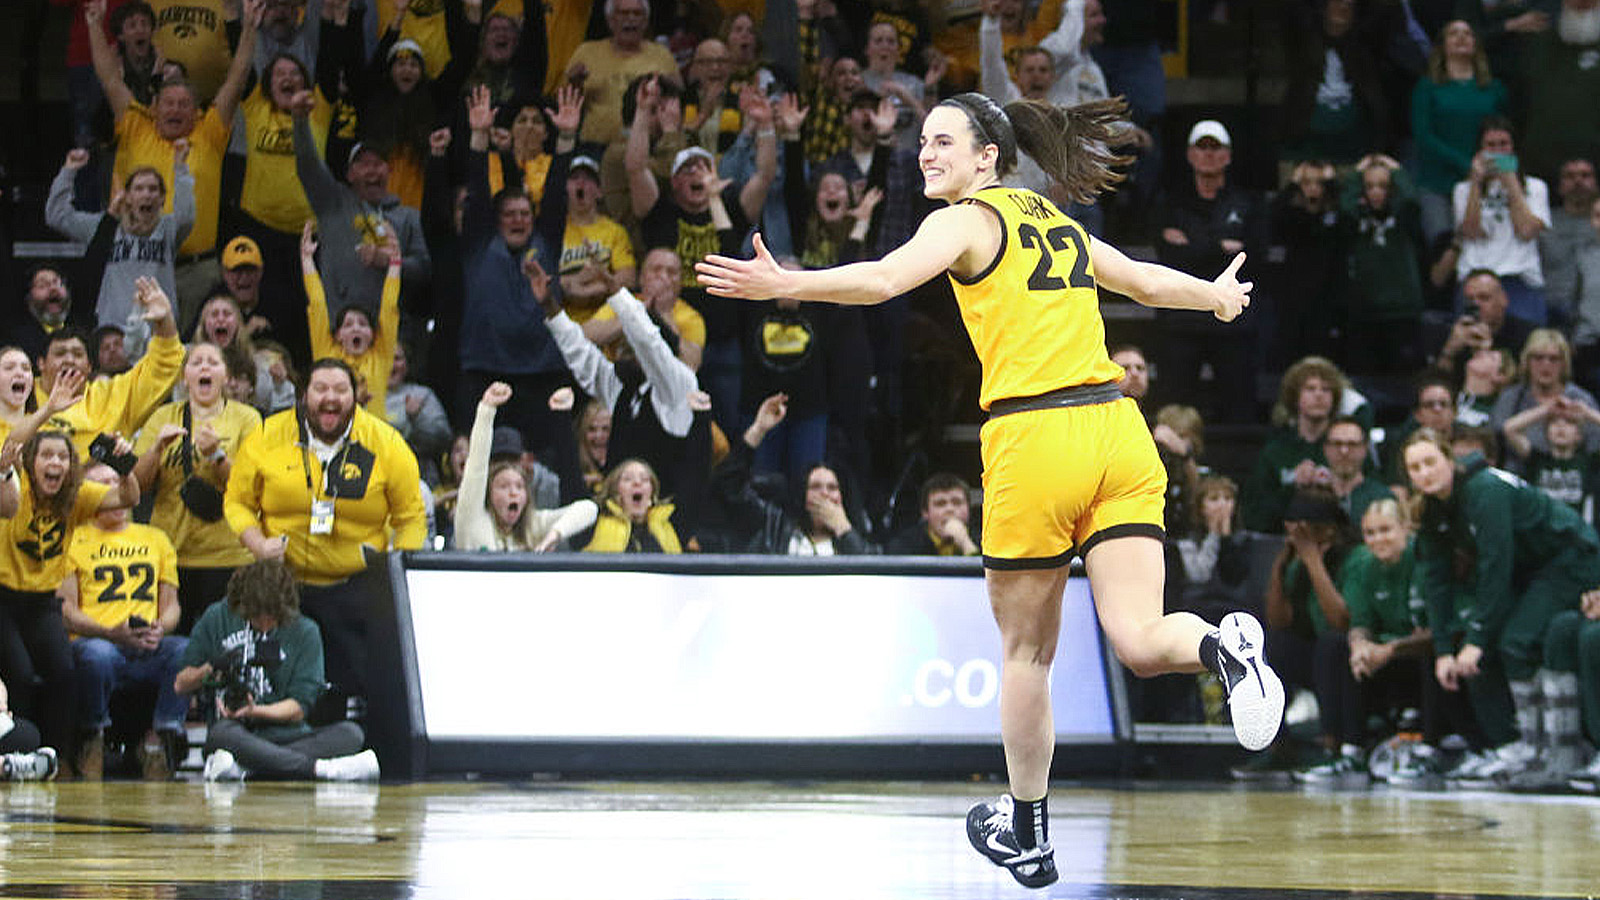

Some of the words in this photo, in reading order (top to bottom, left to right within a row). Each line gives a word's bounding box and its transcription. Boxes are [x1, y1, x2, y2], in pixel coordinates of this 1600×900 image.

[1018, 223, 1095, 291] 22
[91, 543, 150, 560] Iowa
[94, 562, 156, 602] 22
